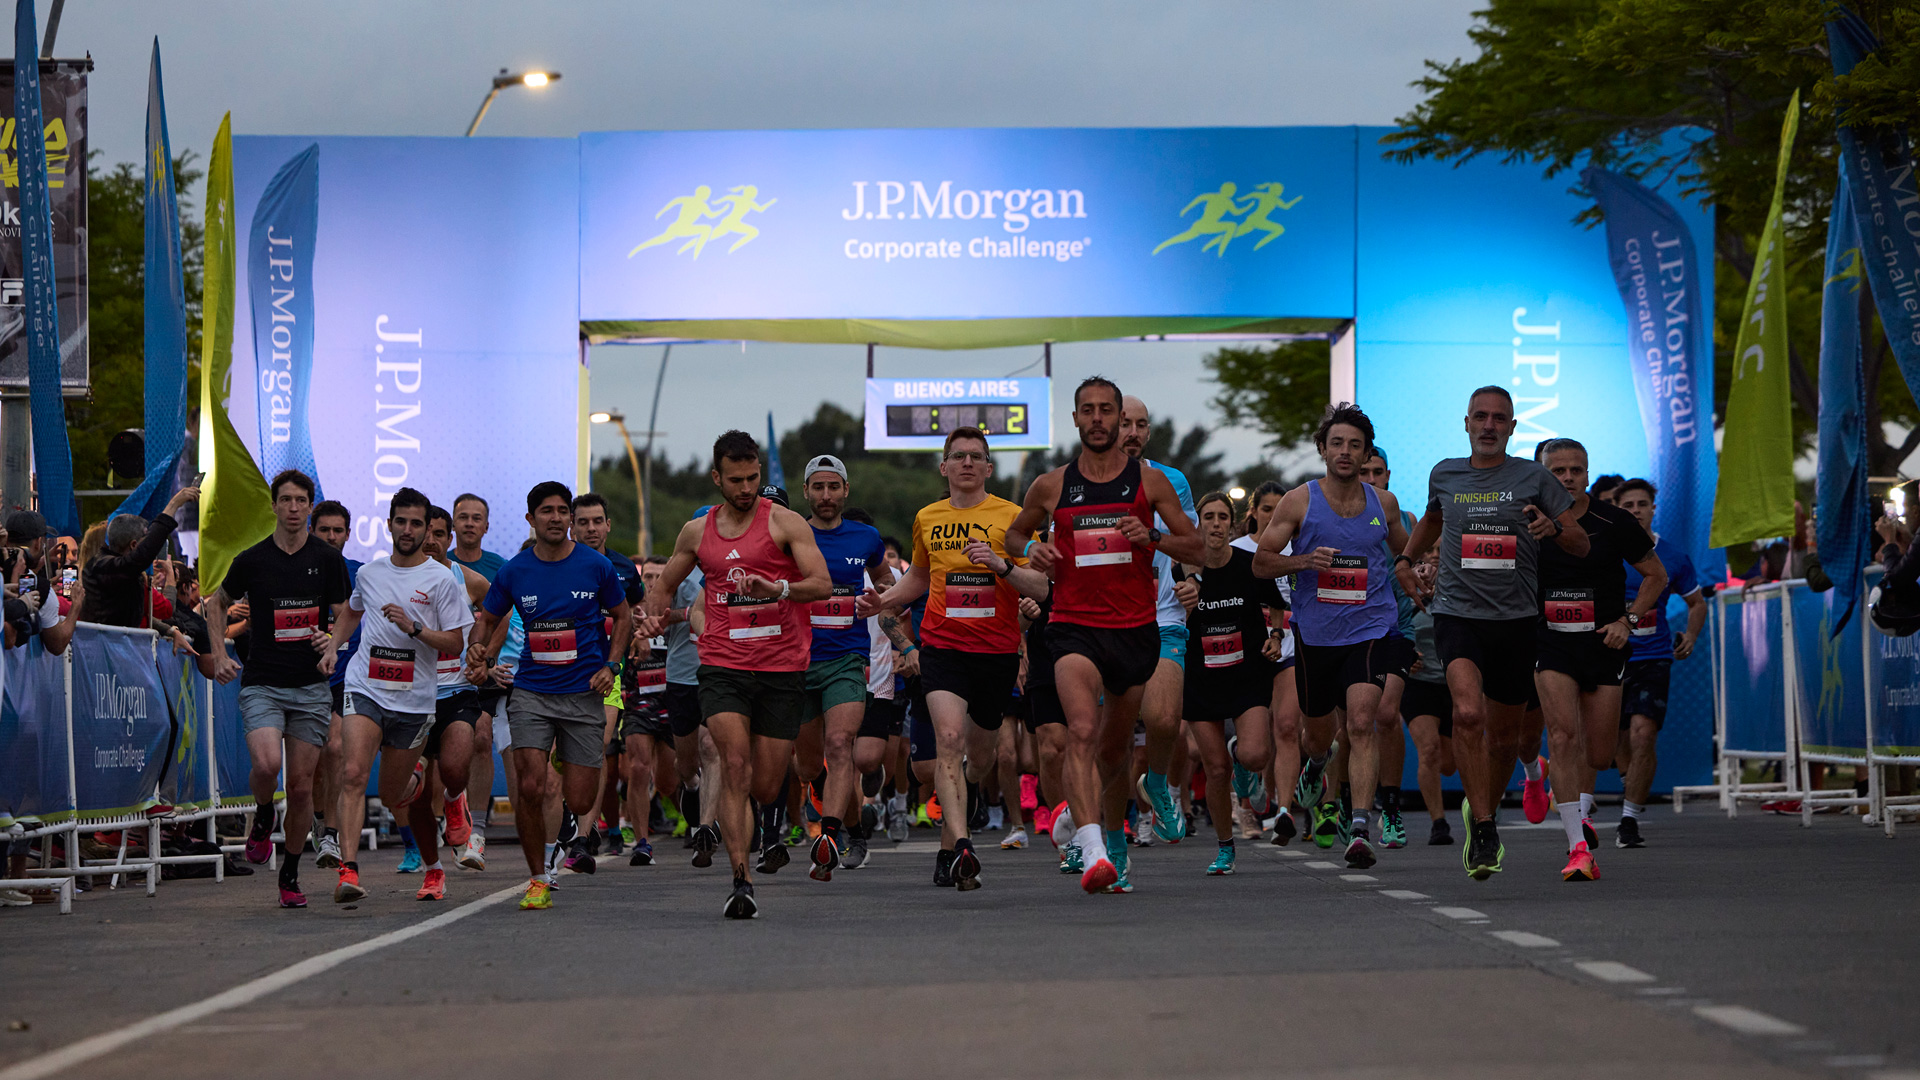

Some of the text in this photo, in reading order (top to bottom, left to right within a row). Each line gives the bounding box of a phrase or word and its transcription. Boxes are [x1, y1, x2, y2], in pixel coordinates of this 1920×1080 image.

[842, 181, 1087, 233] J.P.Morgan
[844, 239, 962, 263] Corporate
[1625, 238, 1656, 343] Corporate
[262, 225, 296, 446] J.P.Morgan
[1652, 230, 1697, 449] J.P.Morgan
[894, 381, 1020, 399] BUENOS AIRES
[1467, 506, 1498, 514] J.P.Morgan
[931, 523, 970, 541] RUN
[1469, 524, 1509, 533] J.P.Morgan
[931, 542, 943, 552] 10K
[945, 541, 961, 551] SAN
[1097, 537, 1108, 552] 3
[1474, 543, 1504, 557] 463
[845, 558, 866, 566] YPF
[952, 576, 989, 584] J.P.Morgan
[1329, 575, 1357, 589] 384
[522, 595, 538, 603] bien
[571, 591, 595, 600] YPF
[961, 593, 980, 606] 24
[1551, 591, 1587, 600] J.P.Morgan
[280, 600, 314, 608] J.P.Morgan
[523, 600, 538, 608] estar
[825, 603, 841, 615] 19
[750, 613, 758, 626] 2
[1556, 608, 1583, 621] 805
[286, 615, 311, 628] 324
[534, 622, 568, 630] J.P.Morgan
[1207, 625, 1237, 634] J.P.Morgan
[544, 639, 561, 650] 30
[1212, 641, 1235, 653] 812
[375, 649, 409, 659] J.P.Morgan
[640, 661, 665, 670] J.P.Morgan
[378, 666, 403, 680] 852
[649, 674, 662, 684] 46
[95, 673, 147, 737] J.P.Morgan
[95, 743, 146, 774] Corporate Challenge
